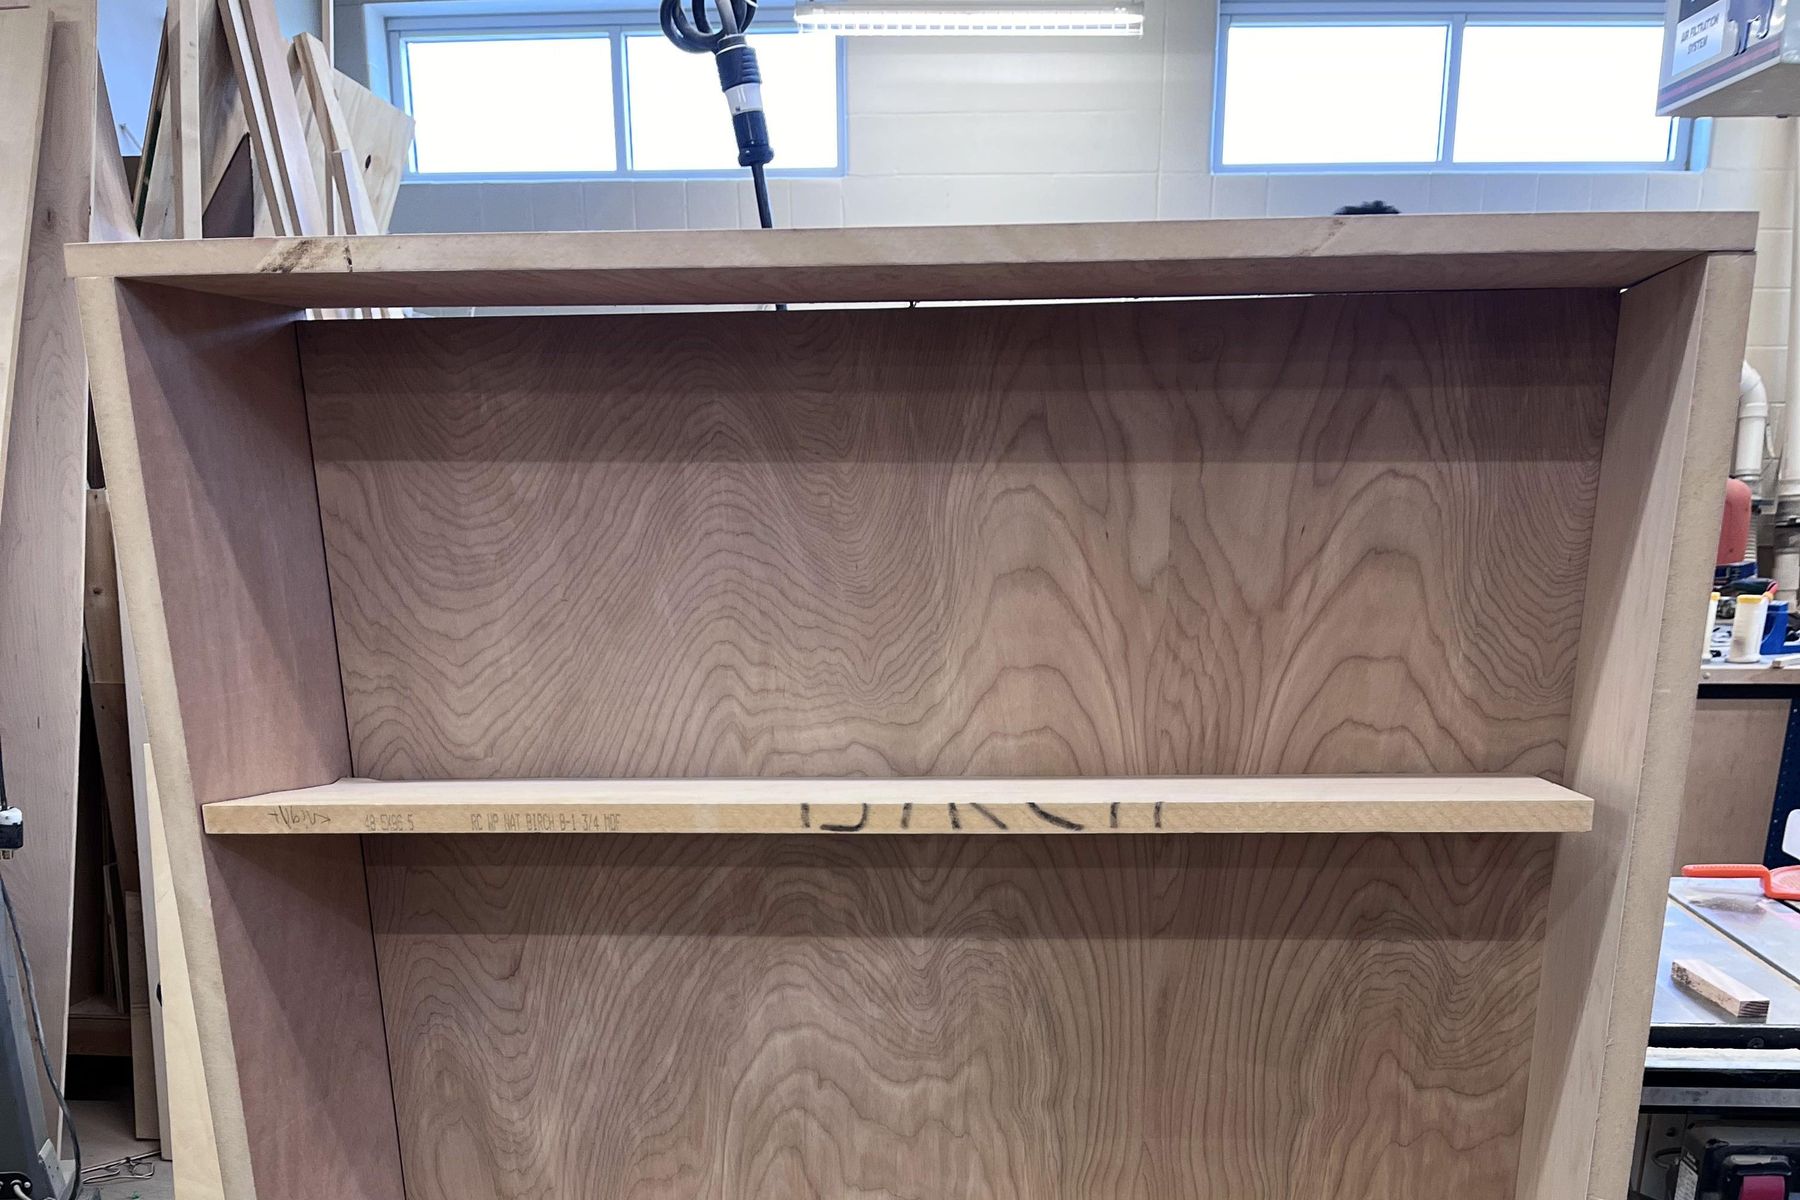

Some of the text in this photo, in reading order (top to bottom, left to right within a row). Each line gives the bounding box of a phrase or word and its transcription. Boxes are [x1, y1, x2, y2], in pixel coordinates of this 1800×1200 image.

[471, 813, 483, 831] RC
[503, 813, 520, 831] NAT
[525, 813, 555, 831] BIRCH
[559, 813, 577, 831] B-1
[581, 813, 600, 831] 3/4
